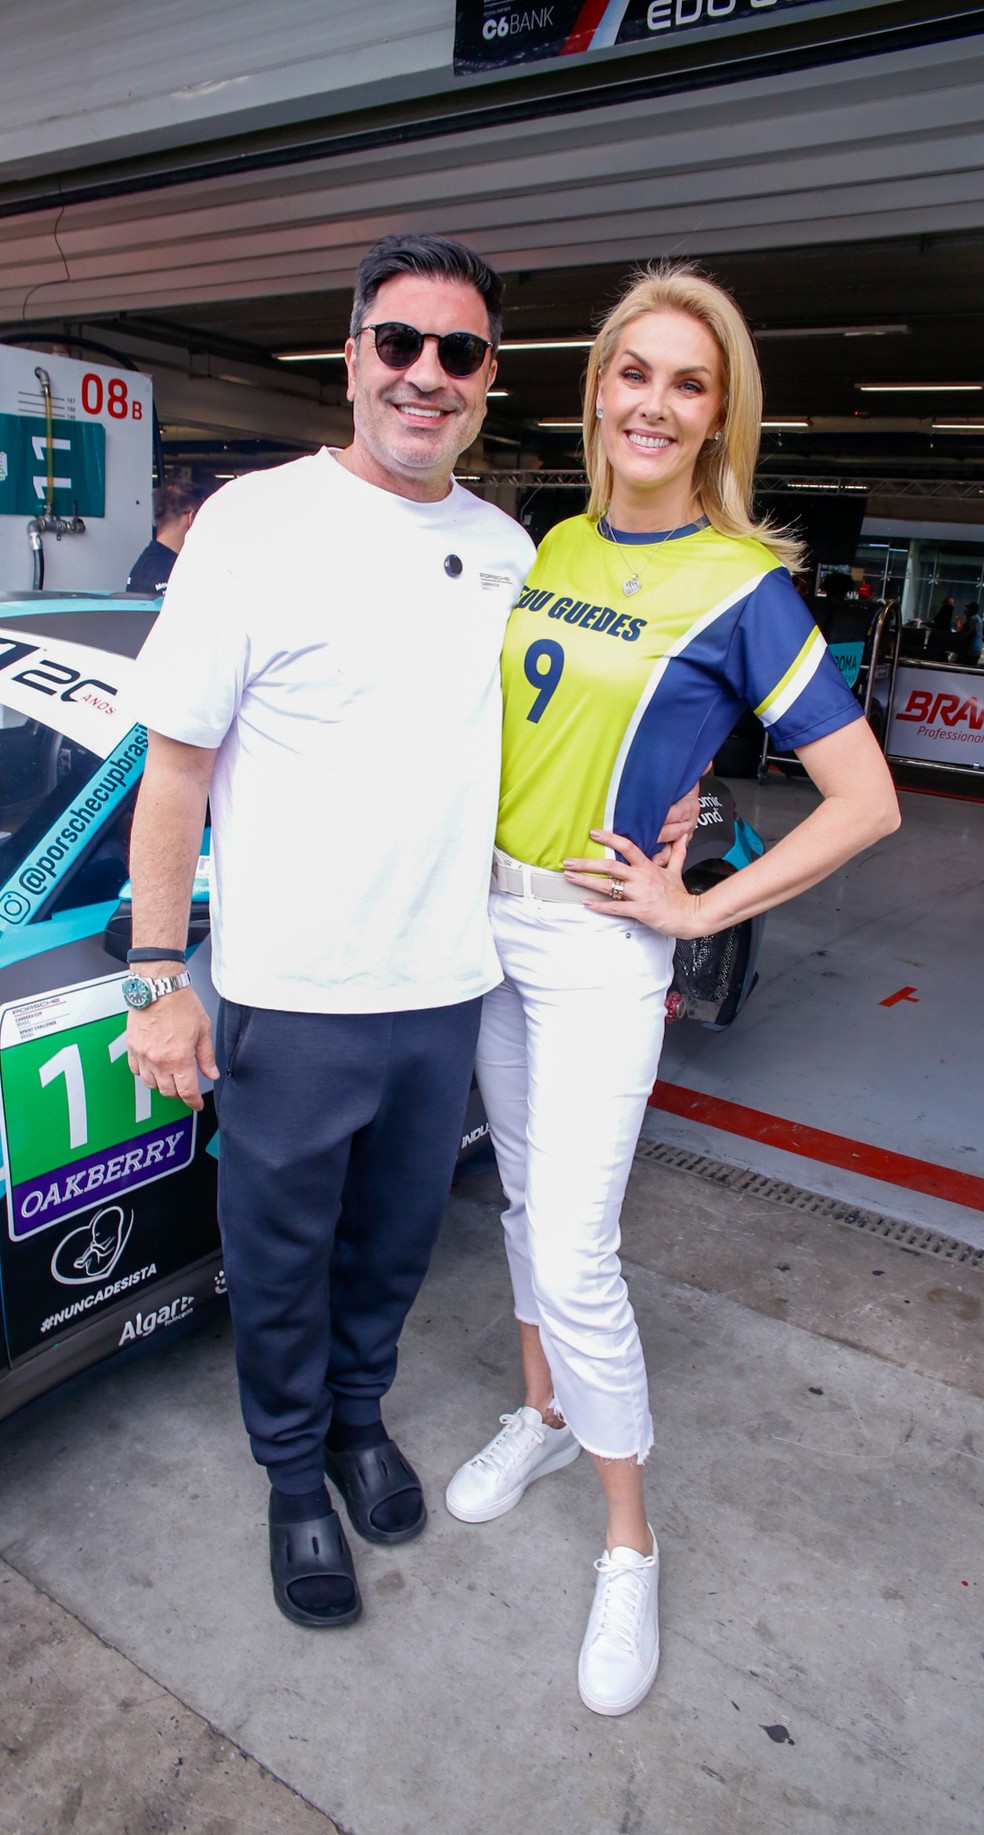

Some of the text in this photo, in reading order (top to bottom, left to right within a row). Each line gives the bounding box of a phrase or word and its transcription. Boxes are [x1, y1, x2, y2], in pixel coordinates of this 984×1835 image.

[547, 597, 648, 642] GUEDES
[523, 638, 565, 724] 9
[82, 694, 114, 715] ANOS
[896, 690, 984, 730] BRA
[12, 998, 60, 1014] PORSCHE
[461, 1122, 490, 1149] INDU
[20, 1130, 184, 1218] OAKBERRY
[40, 1263, 157, 1333] #NUNCADESISTA
[118, 1297, 181, 1346] Algar
